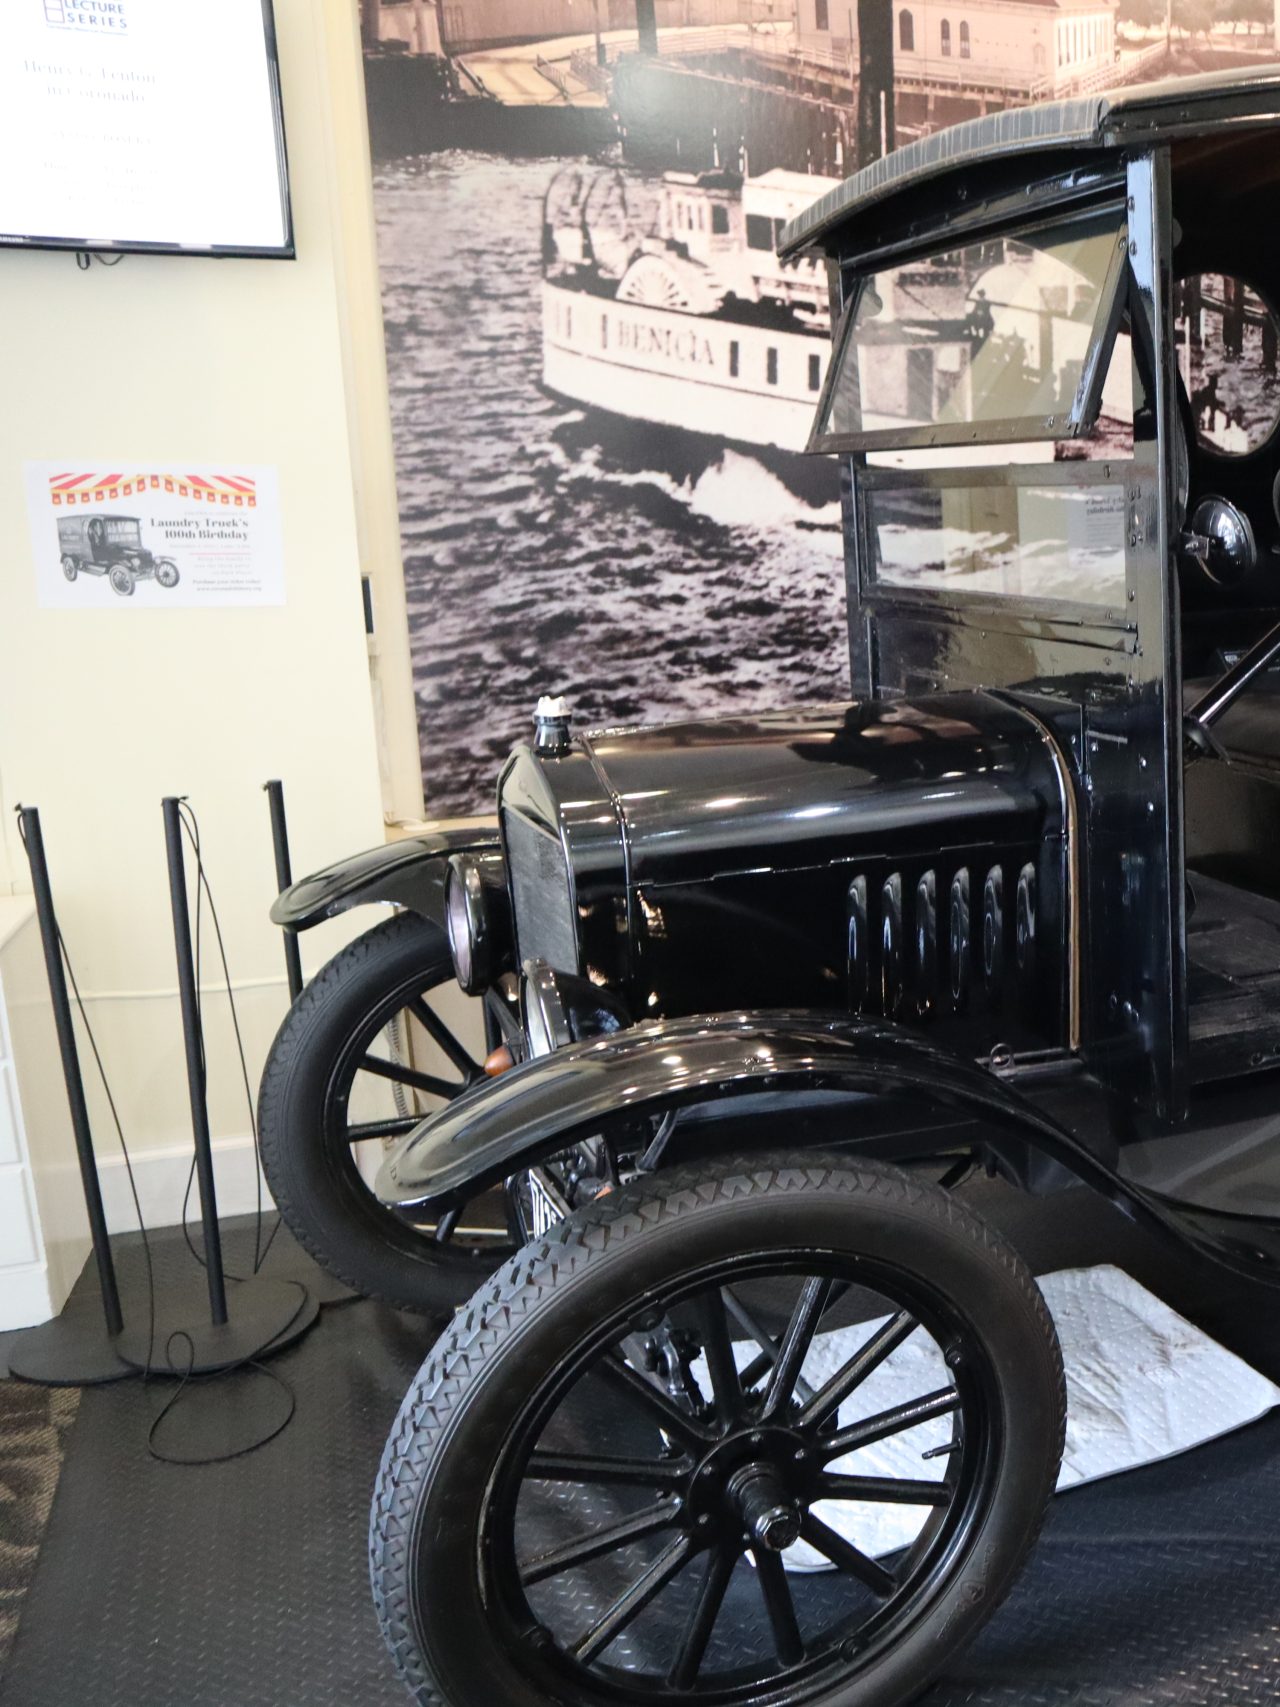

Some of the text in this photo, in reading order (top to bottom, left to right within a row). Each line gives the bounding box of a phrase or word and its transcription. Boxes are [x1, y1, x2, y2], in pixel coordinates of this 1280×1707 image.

[65, 0, 125, 14] LECTURE
[67, 12, 127, 29] SERIES
[618, 320, 715, 365] BENICIA
[150, 518, 200, 529] Laundry
[165, 530, 248, 541] 100th Birthday
